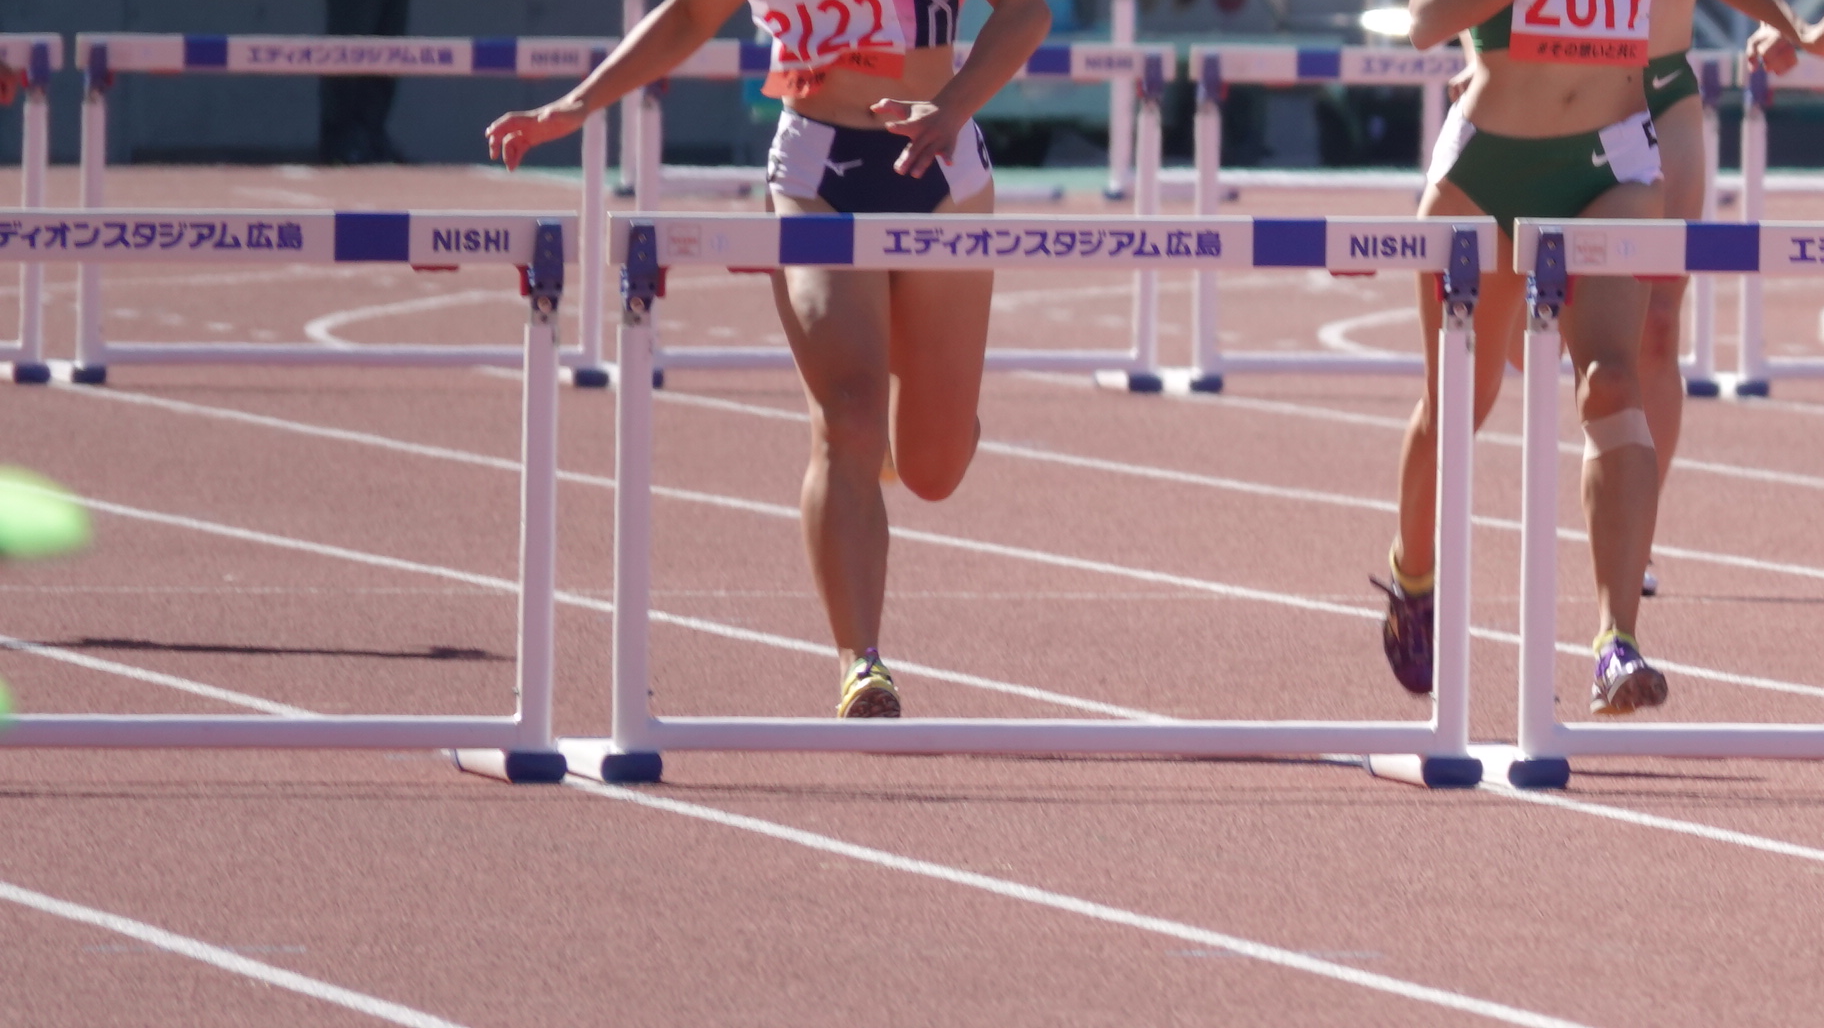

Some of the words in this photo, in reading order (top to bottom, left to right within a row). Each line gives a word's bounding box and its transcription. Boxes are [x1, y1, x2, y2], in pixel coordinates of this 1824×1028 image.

[432, 228, 510, 252] NISHI
[884, 229, 1222, 257] エディオンスタジアム広島
[1349, 235, 1427, 259] NISHI
